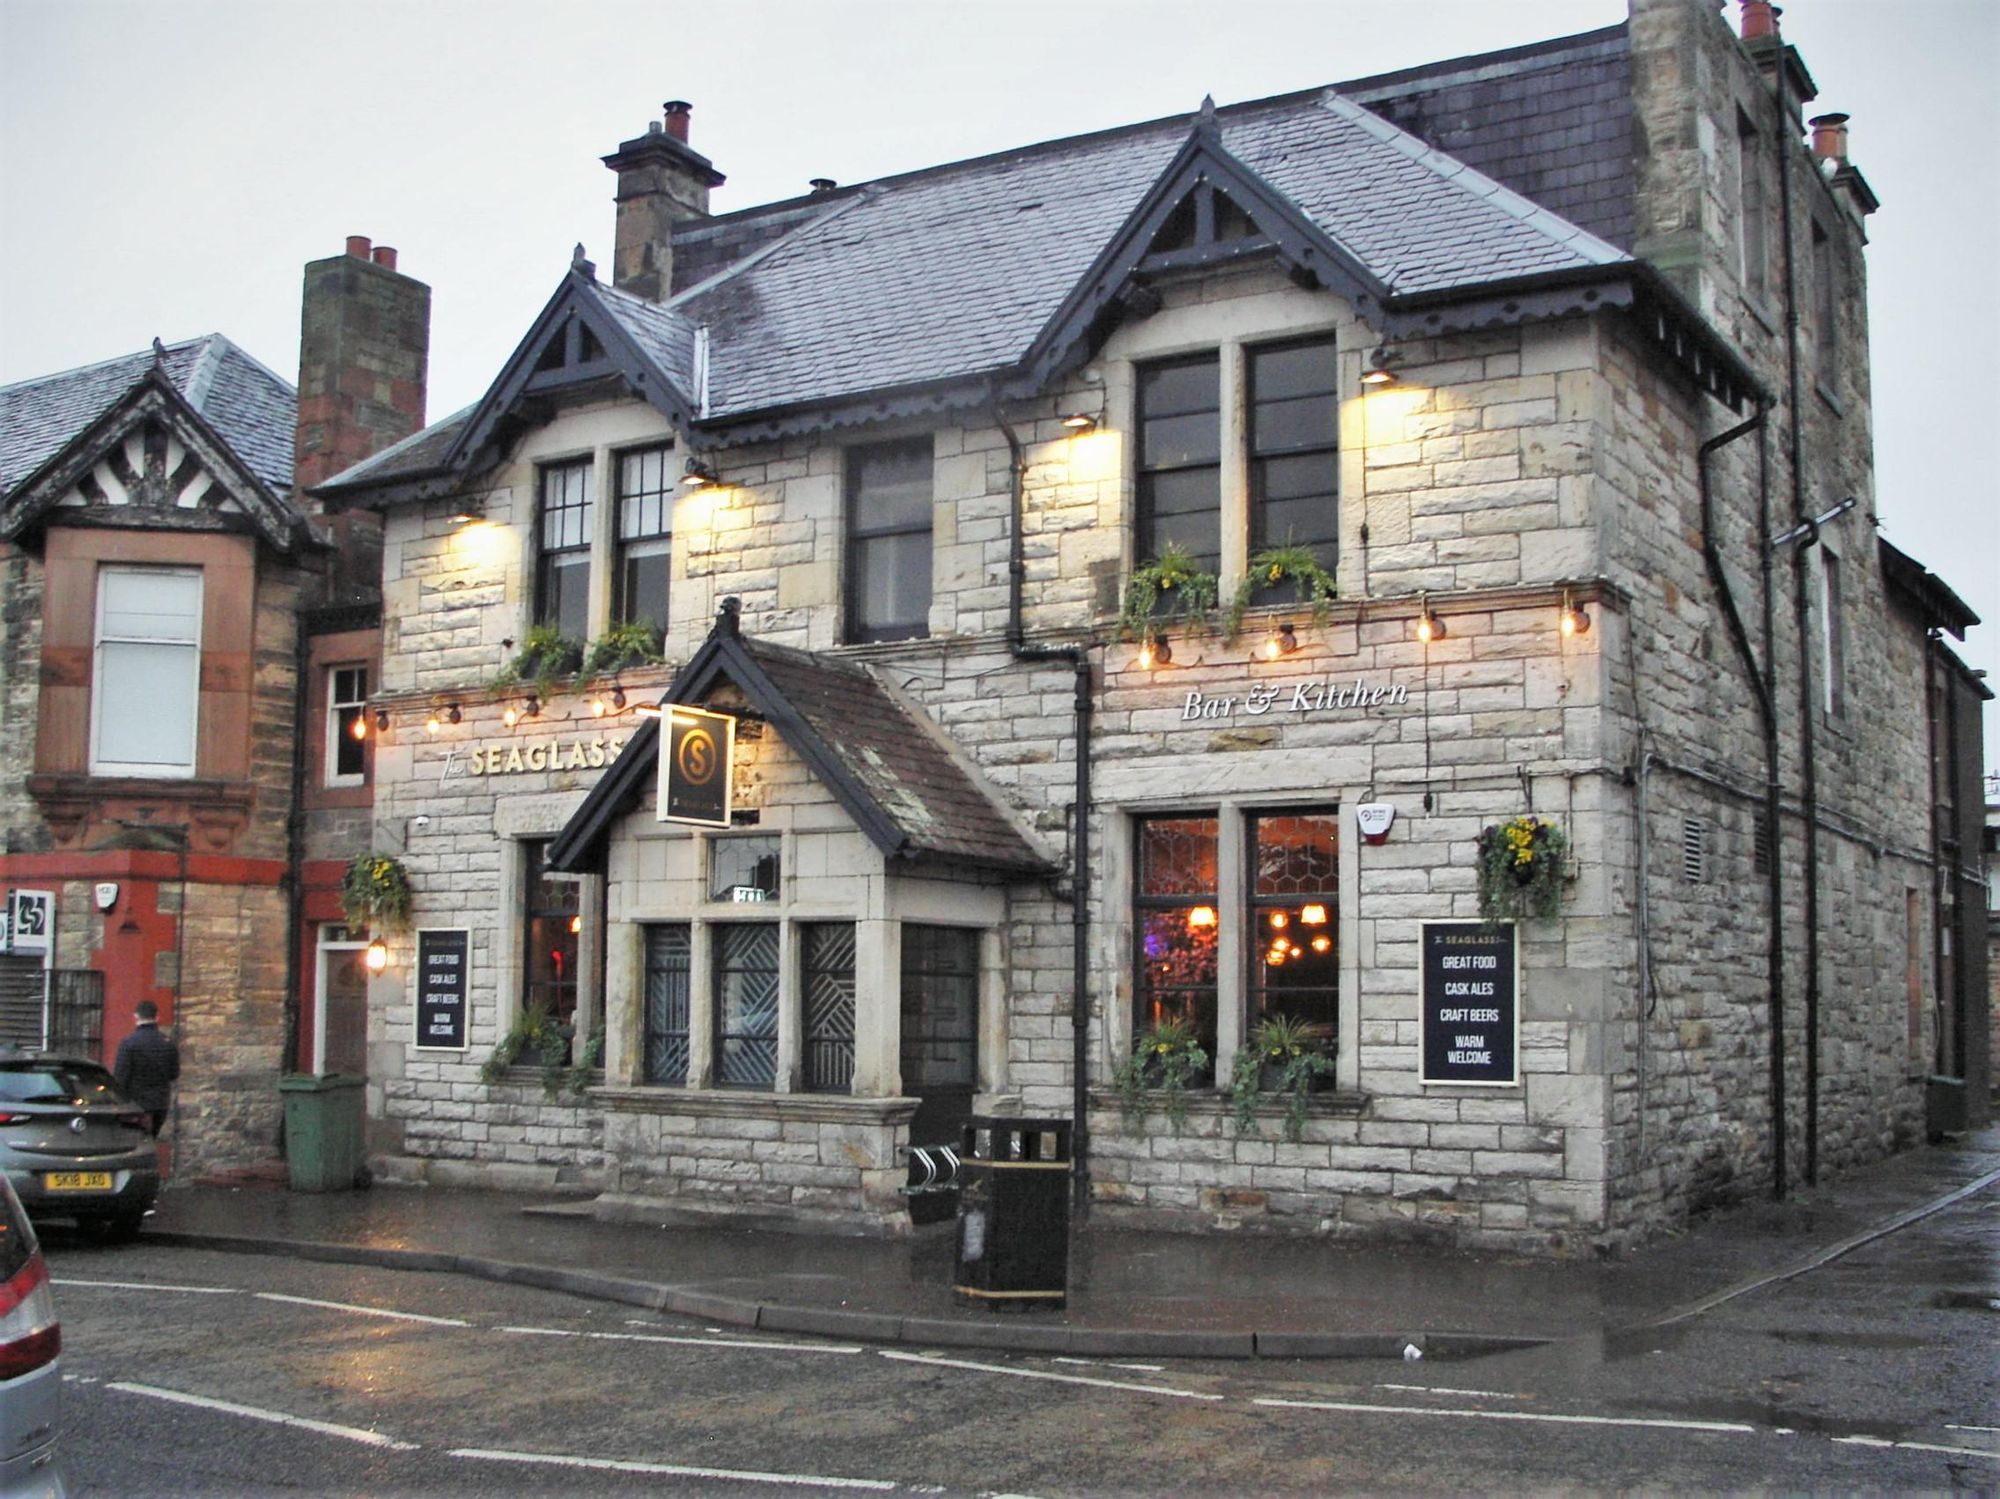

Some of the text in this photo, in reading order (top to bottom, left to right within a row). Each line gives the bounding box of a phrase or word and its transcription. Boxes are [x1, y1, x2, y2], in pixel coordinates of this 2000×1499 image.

[1182, 679, 1408, 721] Bar & Kitchen
[439, 749, 464, 787] The
[1442, 956, 1496, 969] GREAT FOOD
[1445, 983, 1494, 995] CASK ALES
[1440, 1009, 1499, 1022] CRAFT BEERS
[1455, 1036, 1484, 1048] WARM
[1448, 1051, 1492, 1064] WELCOME
